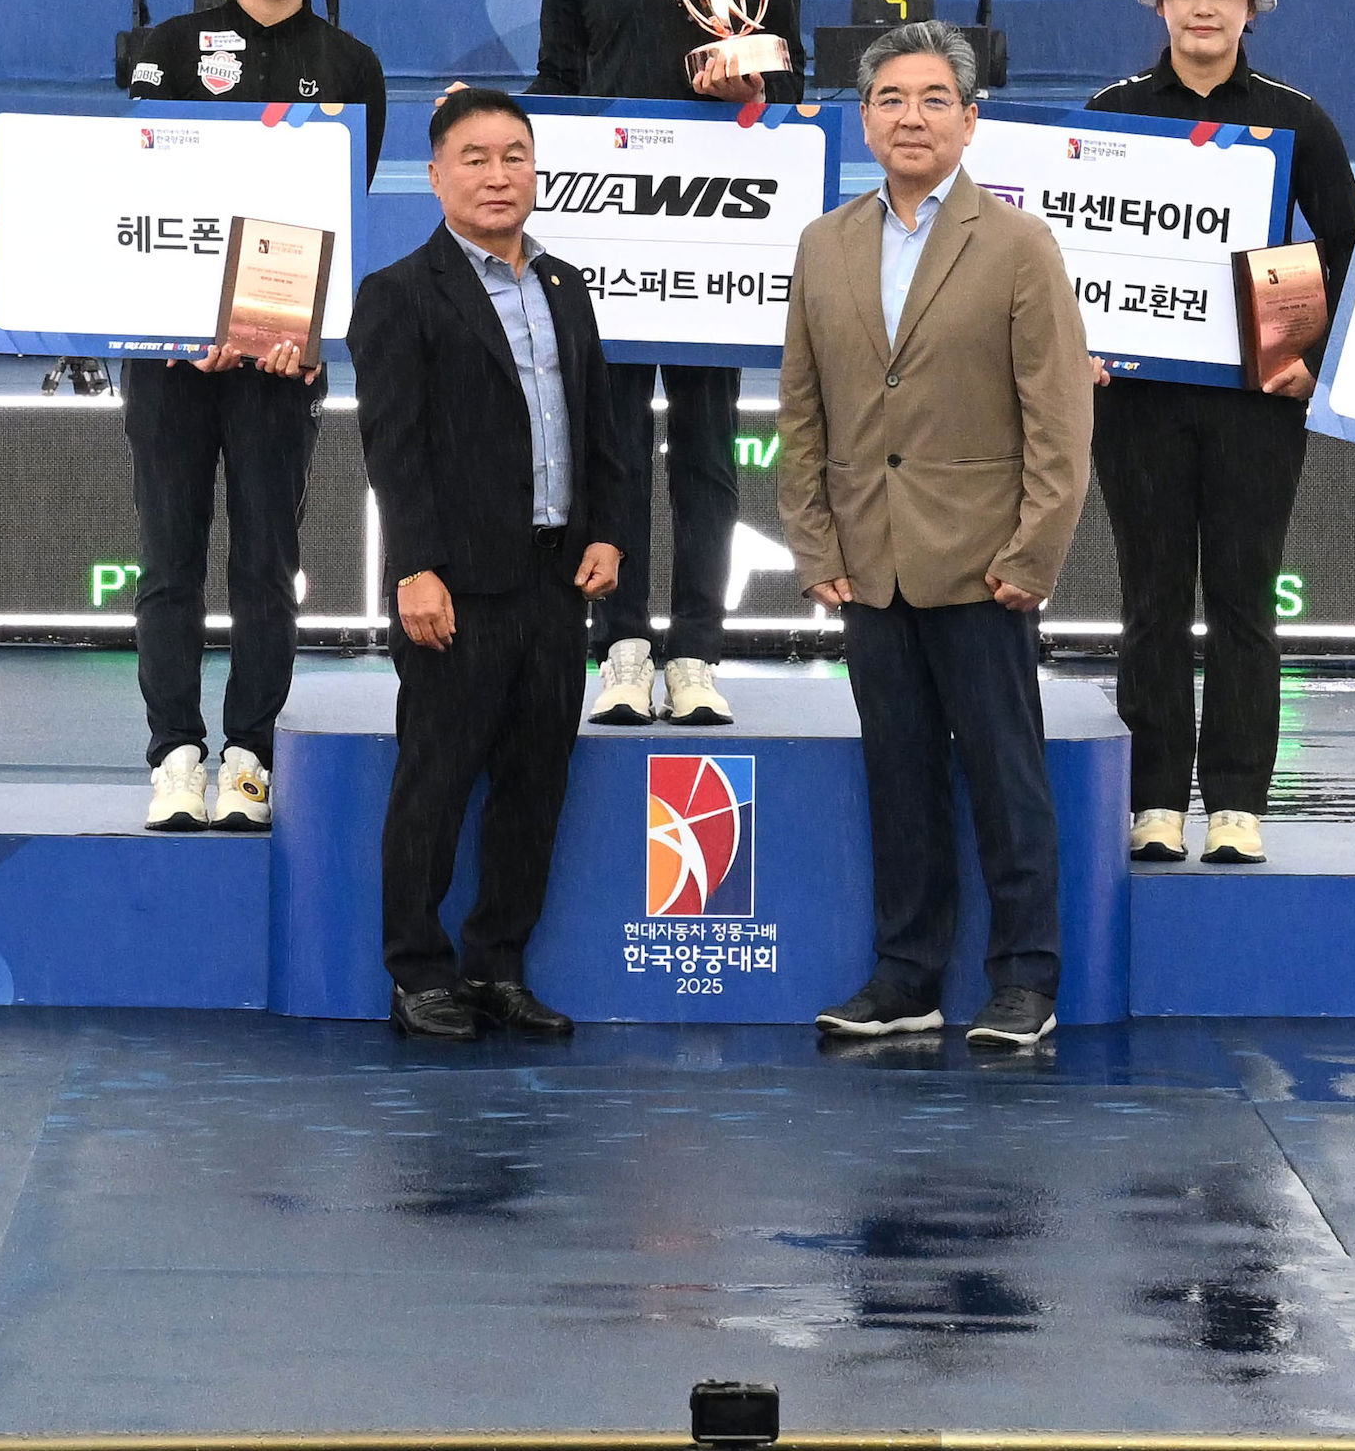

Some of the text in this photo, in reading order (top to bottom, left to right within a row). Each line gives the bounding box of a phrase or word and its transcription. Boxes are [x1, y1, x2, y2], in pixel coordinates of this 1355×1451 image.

[199, 63, 241, 82] MOBIS
[534, 170, 778, 219] VIAWIS
[117, 216, 223, 254] 헤드폰
[1042, 190, 1231, 243] 넥센타이어
[581, 266, 792, 305] 익스퍼트 바이크
[1119, 284, 1208, 322] 교환권
[623, 922, 777, 942] 현대자동차 정몽구배
[623, 944, 777, 975] 한국양궁대회
[676, 977, 724, 995] 2025
